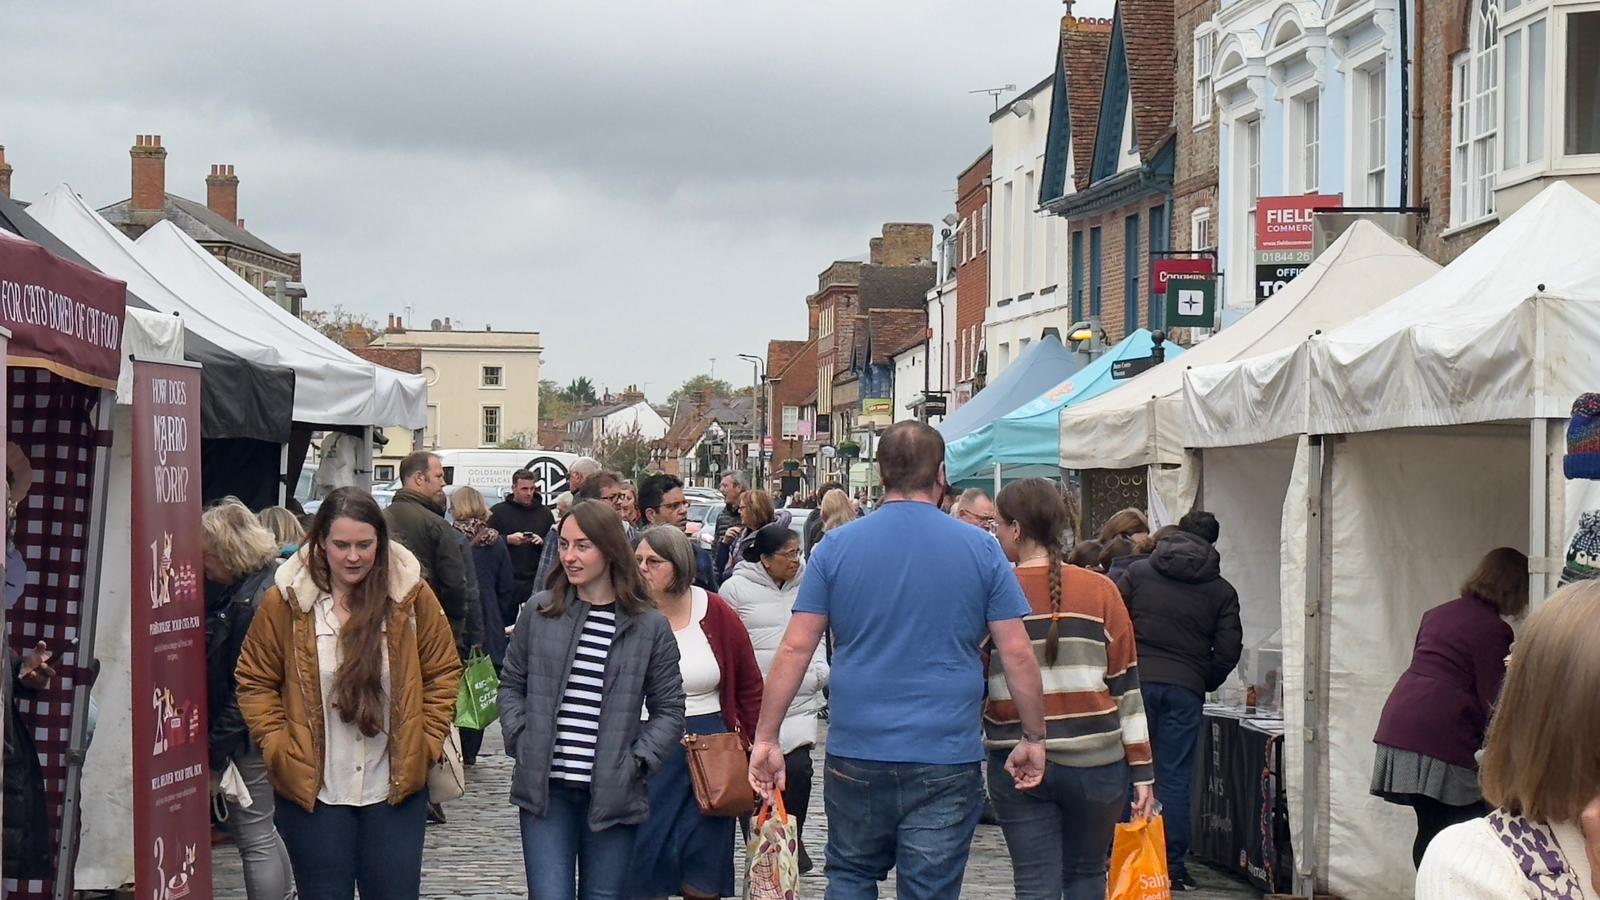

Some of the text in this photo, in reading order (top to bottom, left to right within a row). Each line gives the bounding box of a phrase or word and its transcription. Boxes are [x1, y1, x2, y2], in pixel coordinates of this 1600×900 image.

[1262, 251, 1312, 262] 01844 26
[2, 280, 119, 350] FOR CATS BORED OF CAT FOOD
[152, 378, 187, 405] HOW DOES
[153, 415, 187, 466] MARRO
[154, 465, 189, 503] WORK?
